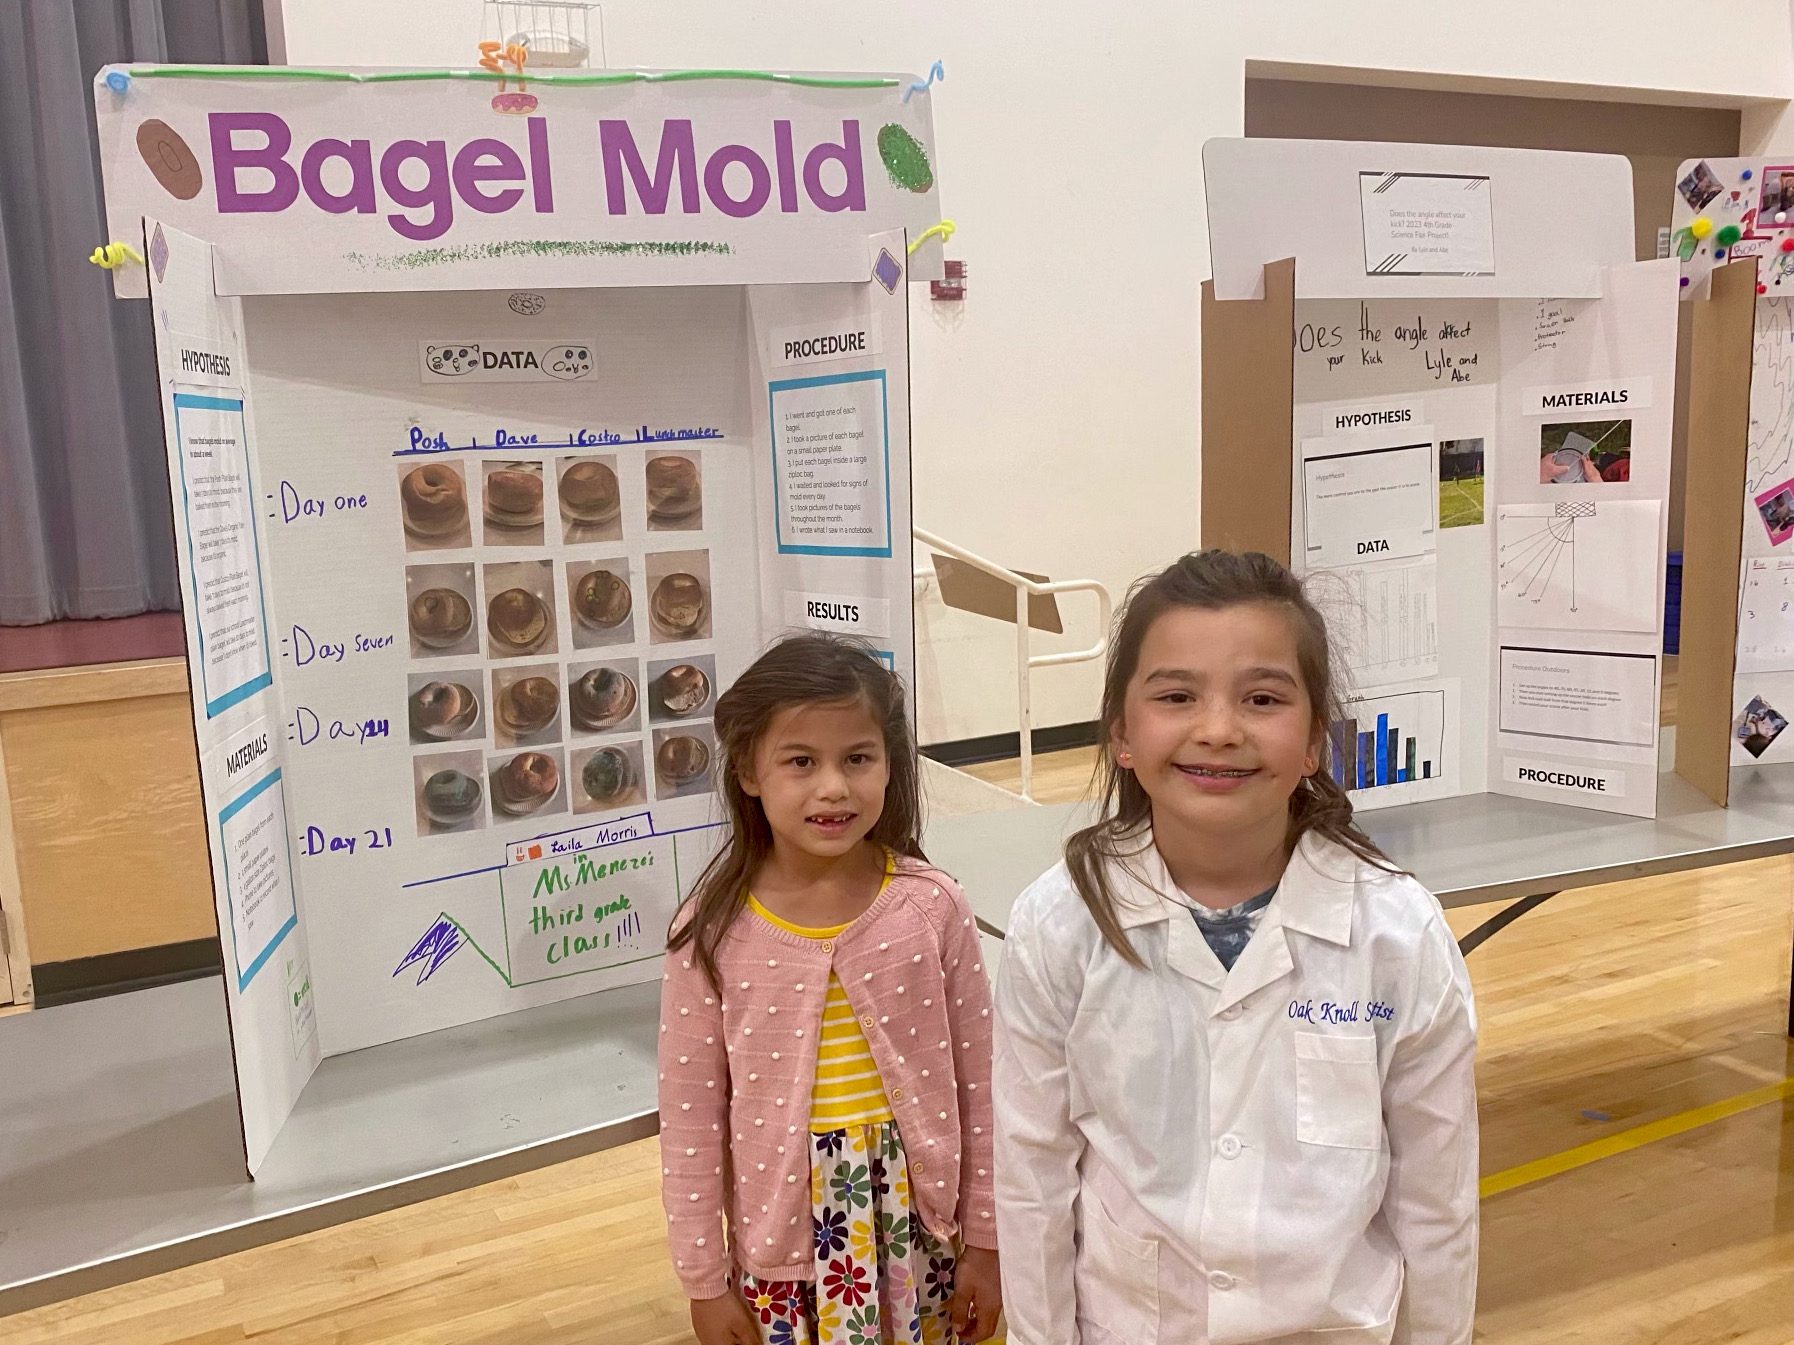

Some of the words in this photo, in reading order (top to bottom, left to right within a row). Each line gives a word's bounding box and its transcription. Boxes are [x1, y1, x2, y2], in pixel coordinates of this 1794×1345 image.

[206, 111, 556, 240] Bagel
[599, 118, 867, 218] Mold
[1358, 300, 1381, 342] the
[1394, 316, 1428, 350] angle
[784, 331, 867, 360] PROCEDURE
[181, 348, 231, 377] HYPOTHESIS
[482, 351, 539, 370] DATA
[1327, 354, 1346, 371] your
[1425, 348, 1452, 380] Lyle
[1459, 353, 1478, 366] and
[1451, 368, 1472, 383] Abe
[1542, 389, 1628, 409] MATERIALS
[1335, 409, 1412, 429] HYPOTHESIS
[410, 426, 450, 450] Posh
[495, 429, 538, 448] Dave
[280, 480, 325, 524] Day
[334, 494, 368, 511] one
[1357, 539, 1390, 555] DATA
[807, 601, 859, 623] RESULTS
[293, 624, 345, 667] Day
[226, 733, 268, 778] MATERIALS
[1518, 767, 1606, 792] PROCEDURE
[307, 825, 356, 856] Day
[364, 827, 392, 849] 21
[550, 837, 584, 853] Laila
[596, 825, 638, 844] Morris
[573, 853, 588, 865] in
[528, 903, 584, 935] third
[1288, 999, 1316, 1025] Oak
[1320, 1000, 1360, 1025] Knoll
